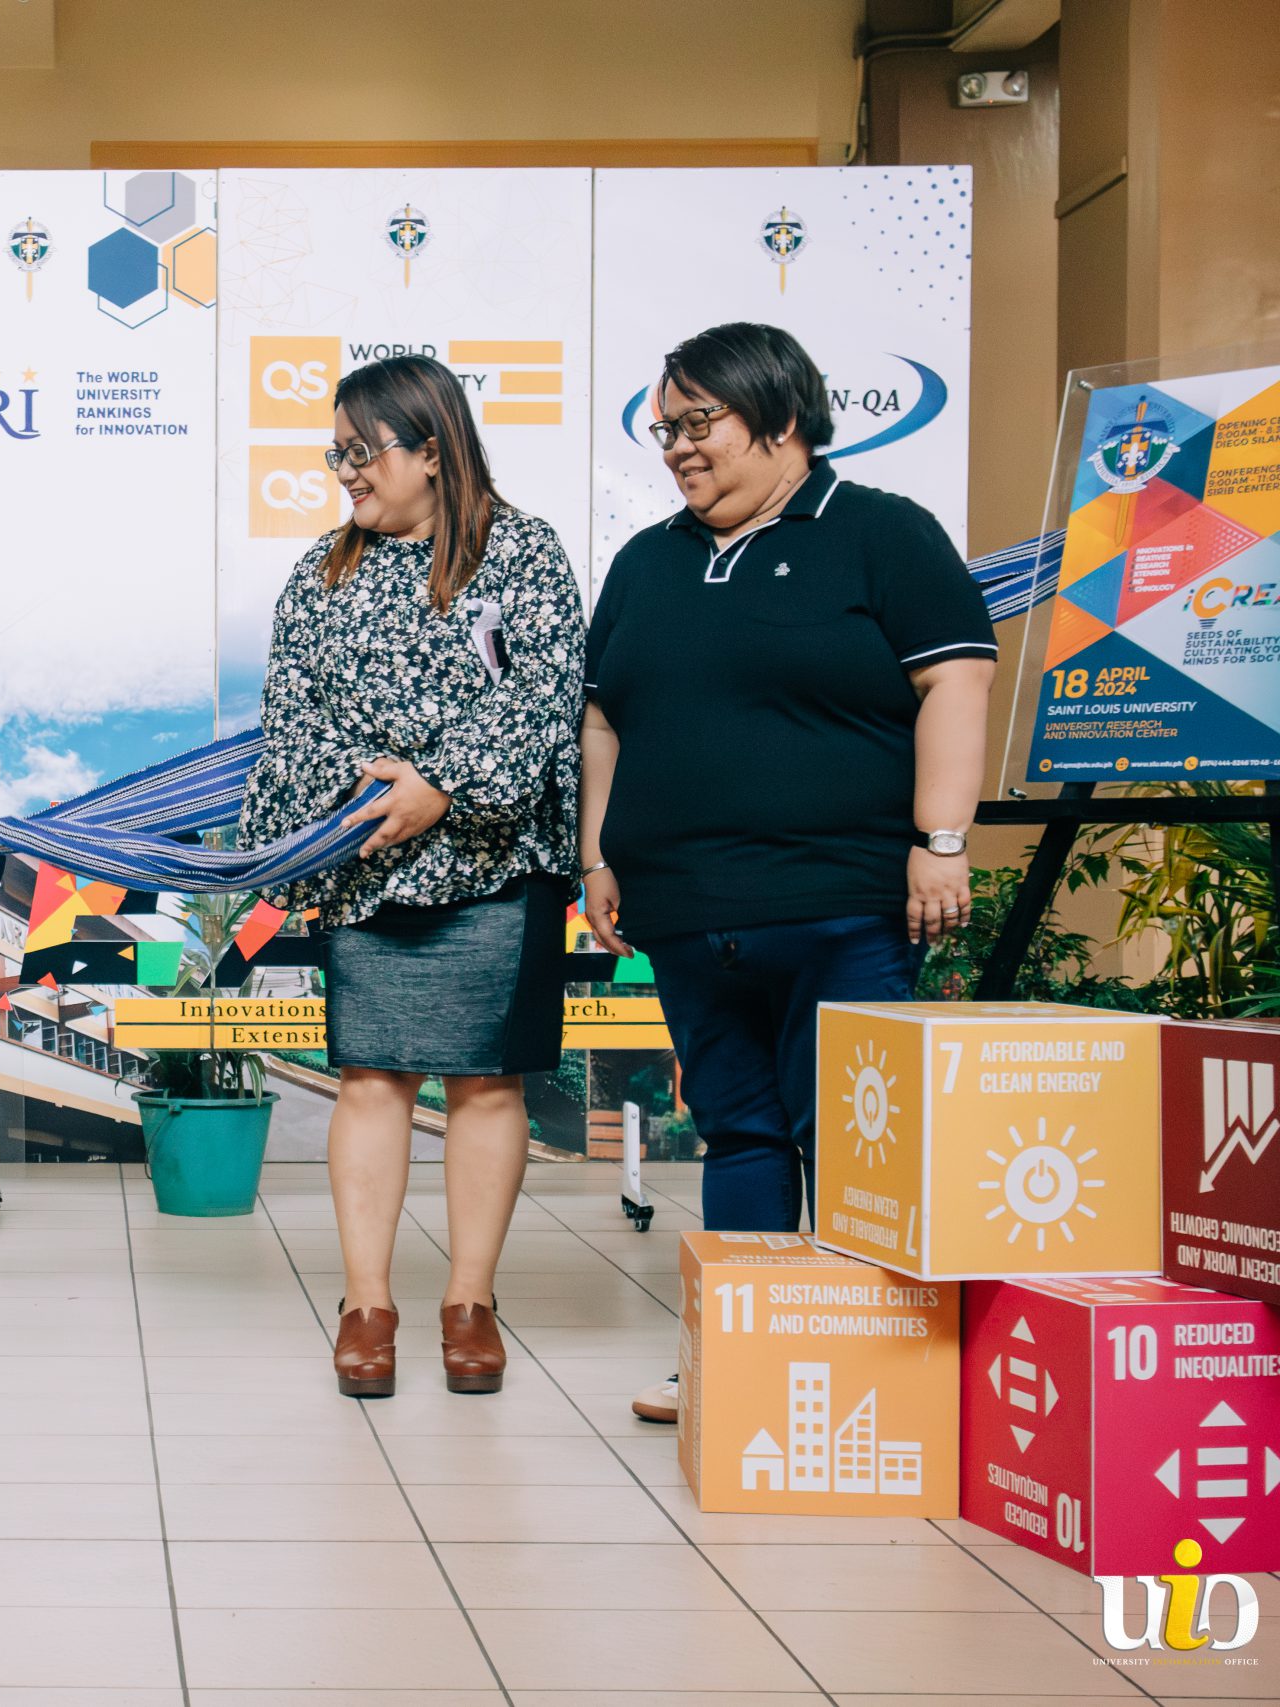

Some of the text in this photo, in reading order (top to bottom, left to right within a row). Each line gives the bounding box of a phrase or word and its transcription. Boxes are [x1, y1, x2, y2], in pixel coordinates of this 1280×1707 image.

[349, 343, 437, 361] WORLD
[76, 371, 158, 383] The WORLD
[261, 361, 328, 407] QS
[76, 389, 161, 400] UNIVERSITY
[829, 388, 900, 417] N-QA
[76, 407, 152, 419] RANKINGS
[75, 424, 188, 436] for INNOVATION
[1218, 417, 1268, 432] OPENING
[261, 470, 328, 516] QS
[1184, 636, 1280, 650] SUSTAINABILITY
[1186, 629, 1243, 641] SEEDS OF
[1182, 654, 1274, 666] MINDS FOR SDG
[1183, 645, 1261, 658] CULTIVATING
[1051, 668, 1089, 699] 18
[1095, 666, 1151, 682] APRIL
[1093, 681, 1137, 697] 2024
[1047, 701, 1198, 716] SAINT LOUIS UNIVERSITY
[1043, 727, 1178, 740] AND INNOVATION CENTER
[1045, 719, 1163, 732] UNIVERSITY RESEARCH
[179, 1000, 328, 1018] Innovations
[939, 1041, 1126, 1094] 7 AFFORDABLE AND
[979, 1071, 1103, 1093] CLEAN ENERGY
[842, 1185, 899, 1220] CLEAN ENERGY
[832, 1204, 919, 1257] 7 AFFORDABLE AND
[1170, 1211, 1219, 1240] GROWTH
[1177, 1244, 1201, 1269] AND
[1202, 1248, 1238, 1277] WORK
[714, 1282, 939, 1333] 11 SUSTAINABLE CITIES
[768, 1313, 928, 1337] AND COMMUNITIES
[1107, 1323, 1256, 1381] 10 REDUCED
[987, 1462, 1049, 1507] INEQUALITIES
[1004, 1492, 1086, 1554] 10 REDUCED
